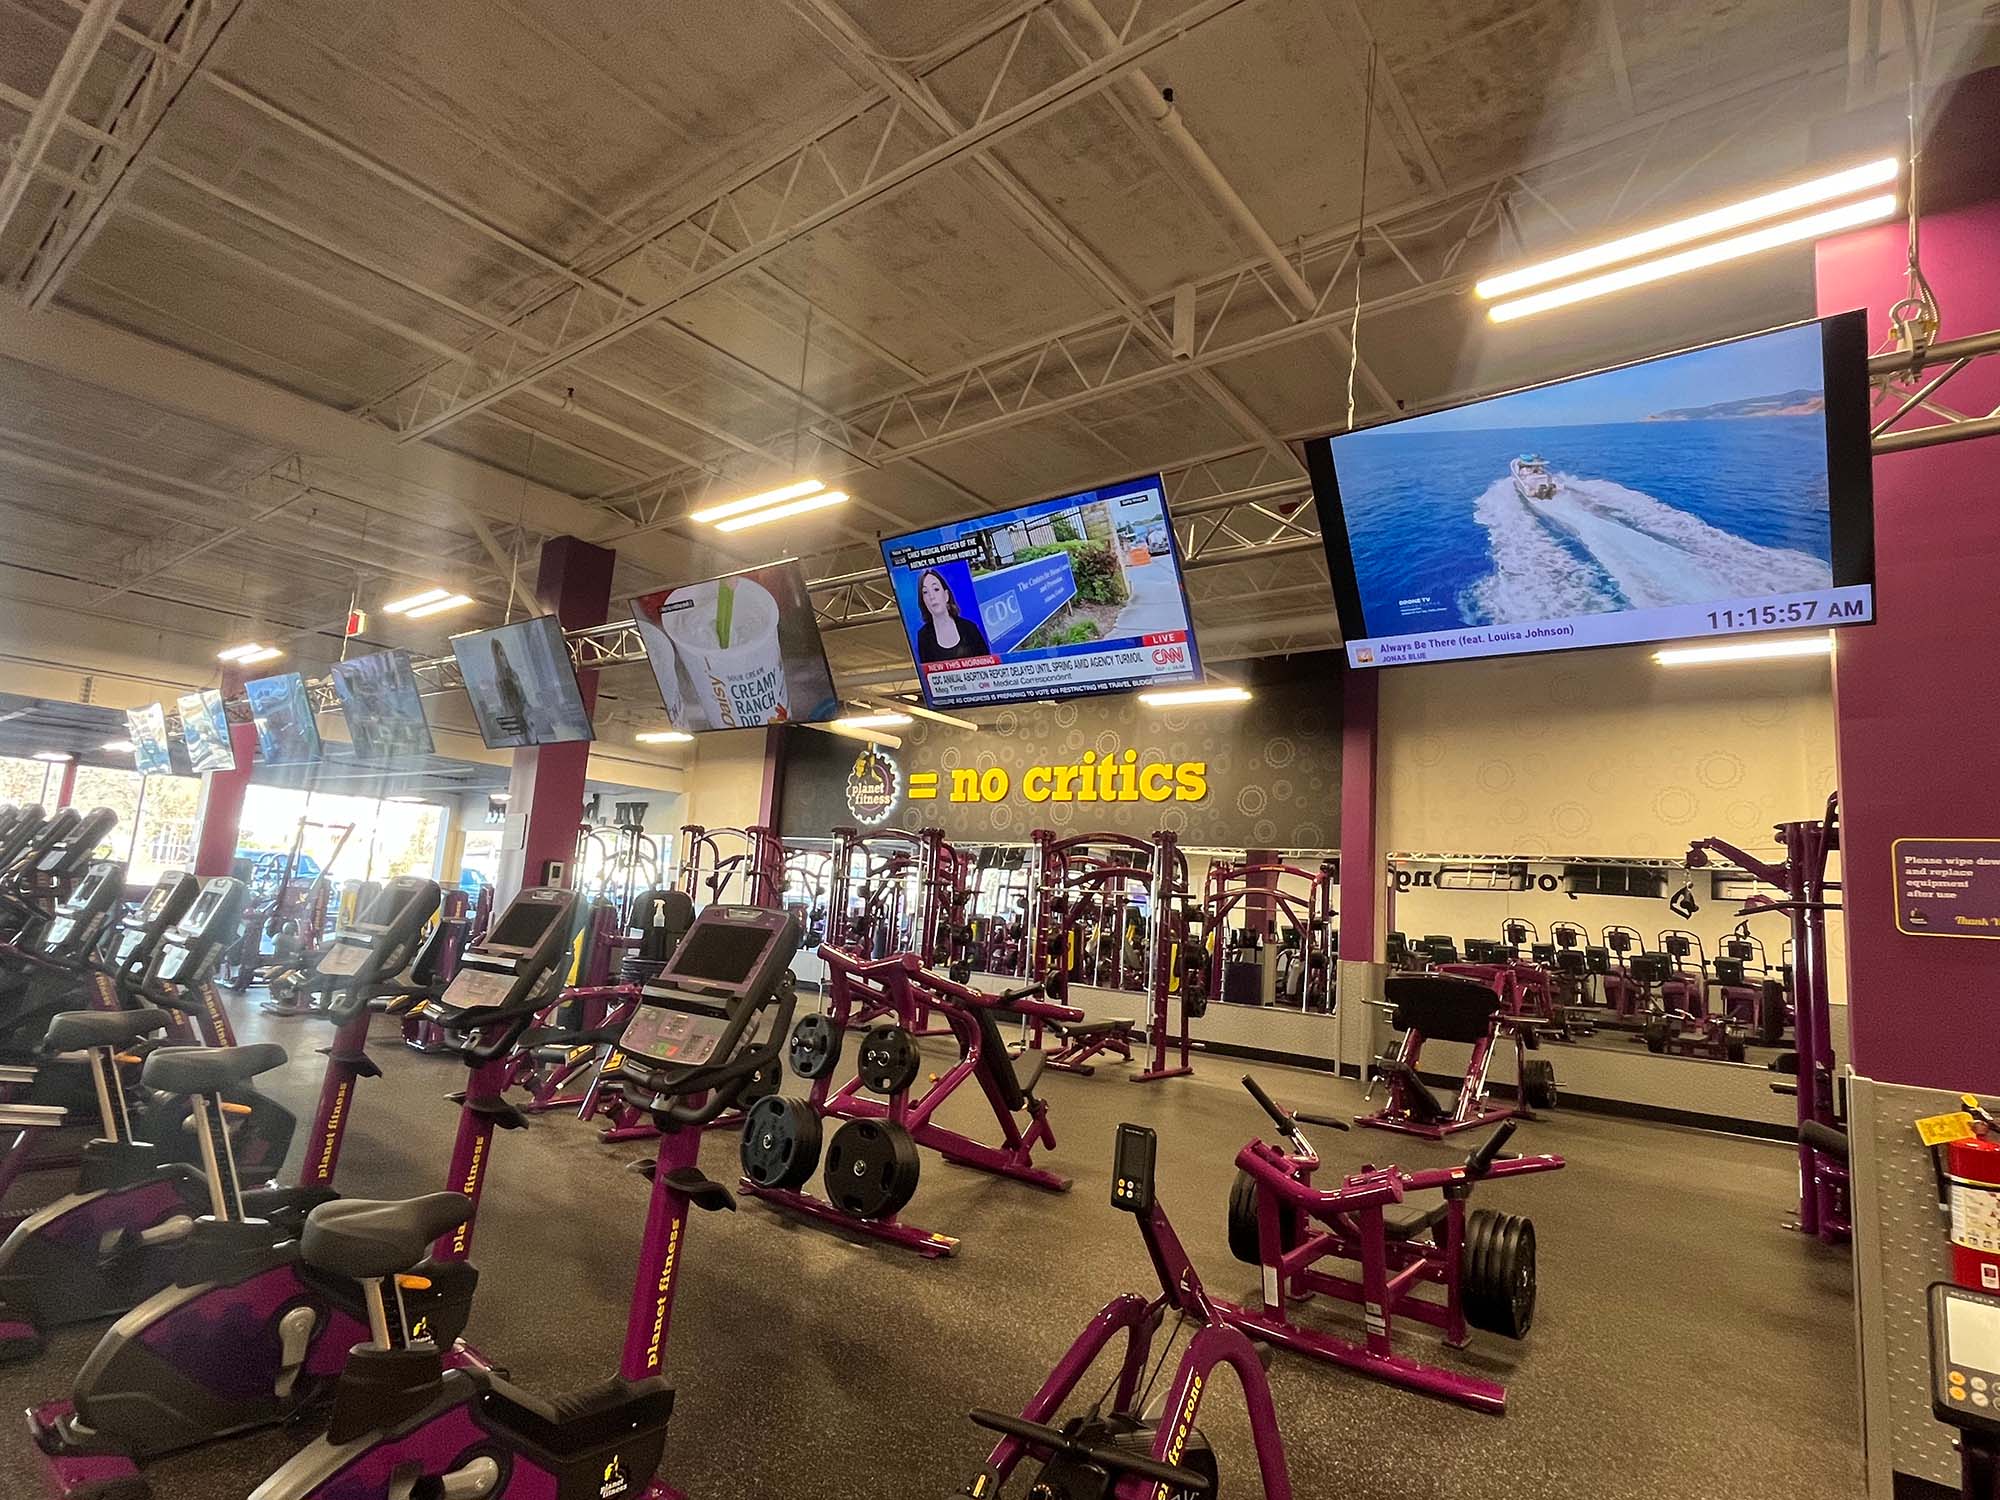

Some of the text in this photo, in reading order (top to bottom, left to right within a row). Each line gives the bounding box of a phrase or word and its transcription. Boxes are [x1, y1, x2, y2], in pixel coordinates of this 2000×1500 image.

[907, 550, 920, 559] CHIEF
[920, 547, 940, 556] MEDICAL
[940, 542, 960, 552] OFFICER
[936, 553, 958, 563] DEBORAH
[985, 595, 1018, 626] CDC
[1707, 600, 1864, 630] 11:15:57 AM
[1152, 633, 1175, 644] LIVE
[1380, 624, 1575, 654] Always Be There (feat. Louisa Johnson)
[928, 656, 995, 672] NEW THIS MORNING
[1152, 647, 1184, 665] CNN
[1382, 652, 1427, 663] JONAS BLUE
[932, 652, 1144, 686] CDC ANNUAL ABORTION REPORT DELAYED UNTIL SPRING AMID AGENCY TURMOIL
[731, 668, 776, 700] CREAMY
[934, 685, 950, 694] Meg
[993, 678, 1020, 687] Medical
[1020, 672, 1072, 686] Correspondent
[964, 695, 991, 704] CONGRESS
[996, 692, 1026, 700] PREPARING
[1035, 688, 1050, 696] VOTE
[1060, 684, 1097, 694] RESTRICTING
[1108, 681, 1132, 689] TRAVEL
[734, 690, 776, 714] RANCH
[740, 714, 761, 728] DIP
[950, 767, 1009, 802] no
[1022, 748, 1208, 803] critics
[852, 782, 884, 797] planet
[855, 794, 890, 804] fitness
[1904, 856, 1942, 865] Please
[1945, 857, 1974, 867] wipe
[1905, 868, 1974, 878] and replace
[1906, 880, 1969, 889] equipment
[1906, 890, 1934, 898] after
[1954, 916, 1989, 926] Thank
[200, 984, 217, 1022] planet
[318, 1082, 348, 1179] planet fitness
[464, 1136, 485, 1194] fitness
[646, 1218, 680, 1369] planet fitness
[1168, 1376, 1202, 1466] free zone
[600, 1478, 624, 1495] planet
[602, 1483, 628, 1499] fitness
